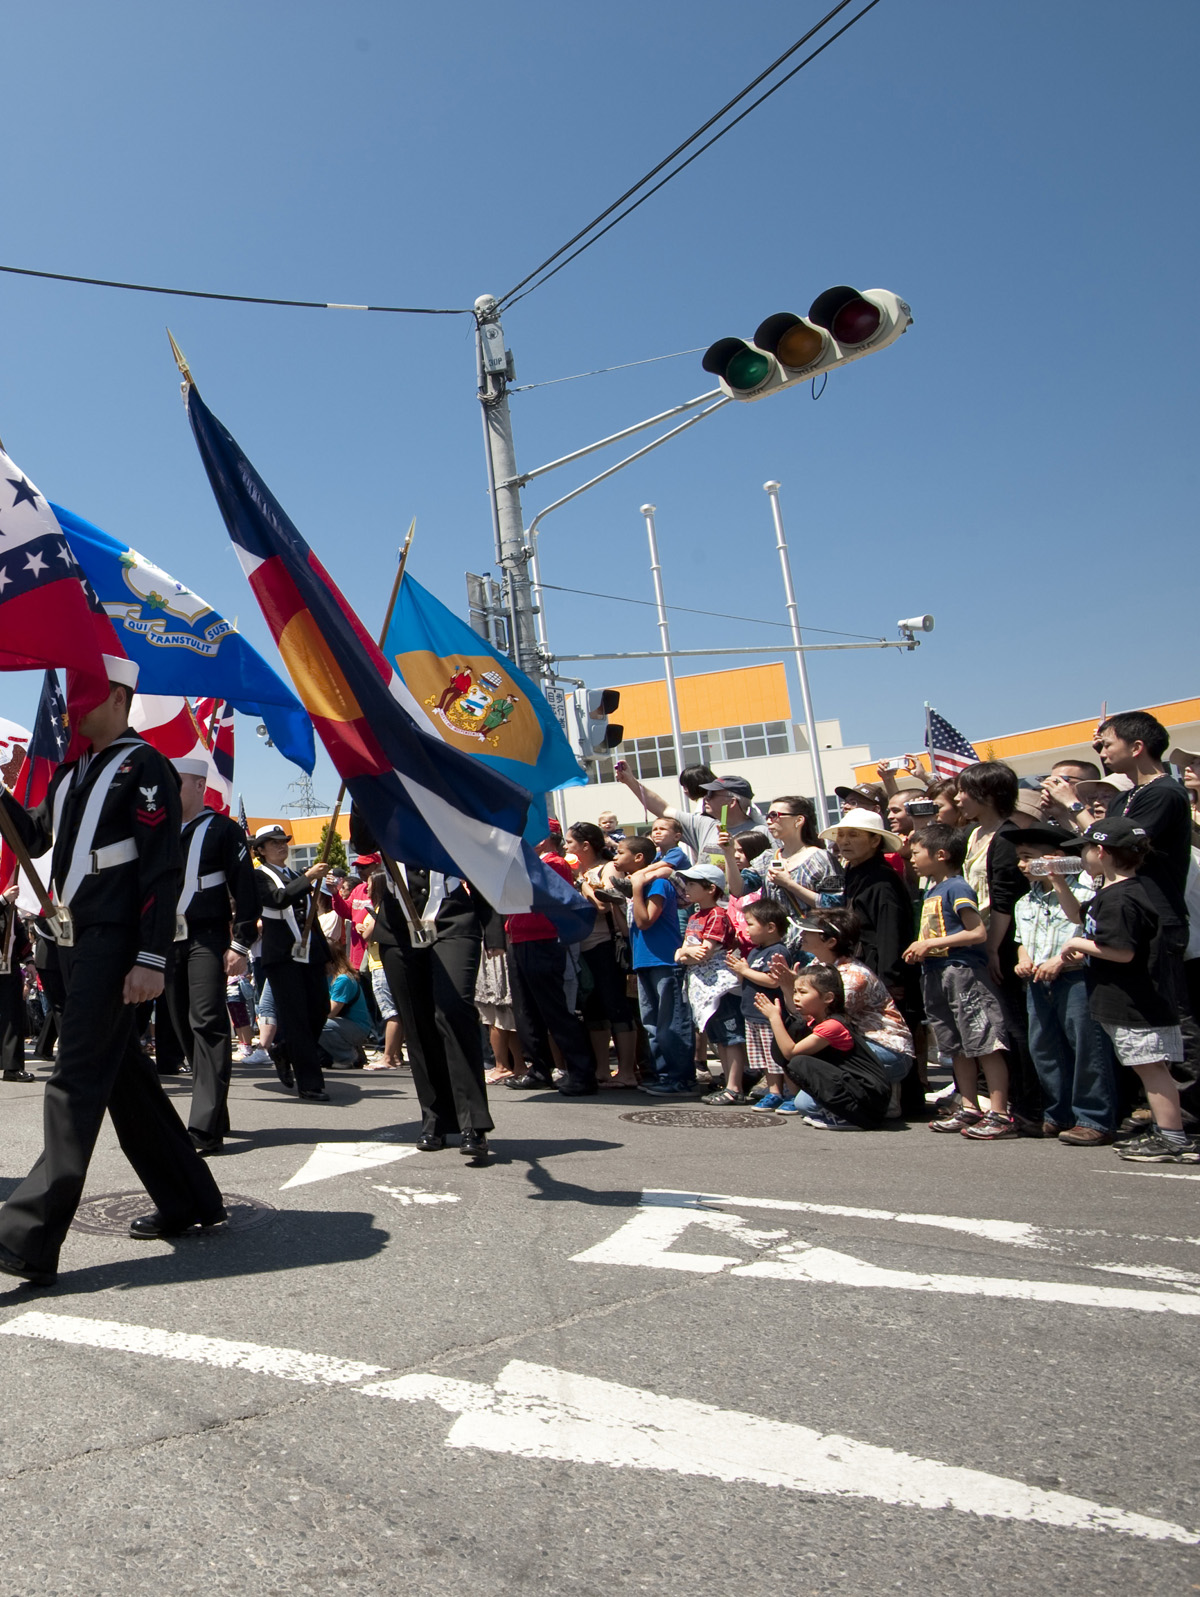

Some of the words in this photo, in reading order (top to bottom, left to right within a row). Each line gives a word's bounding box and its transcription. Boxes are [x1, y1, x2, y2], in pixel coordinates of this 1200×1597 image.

[128, 620, 148, 631] QUI
[150, 632, 212, 653] TRANSTULIT
[207, 622, 233, 640] SUST
